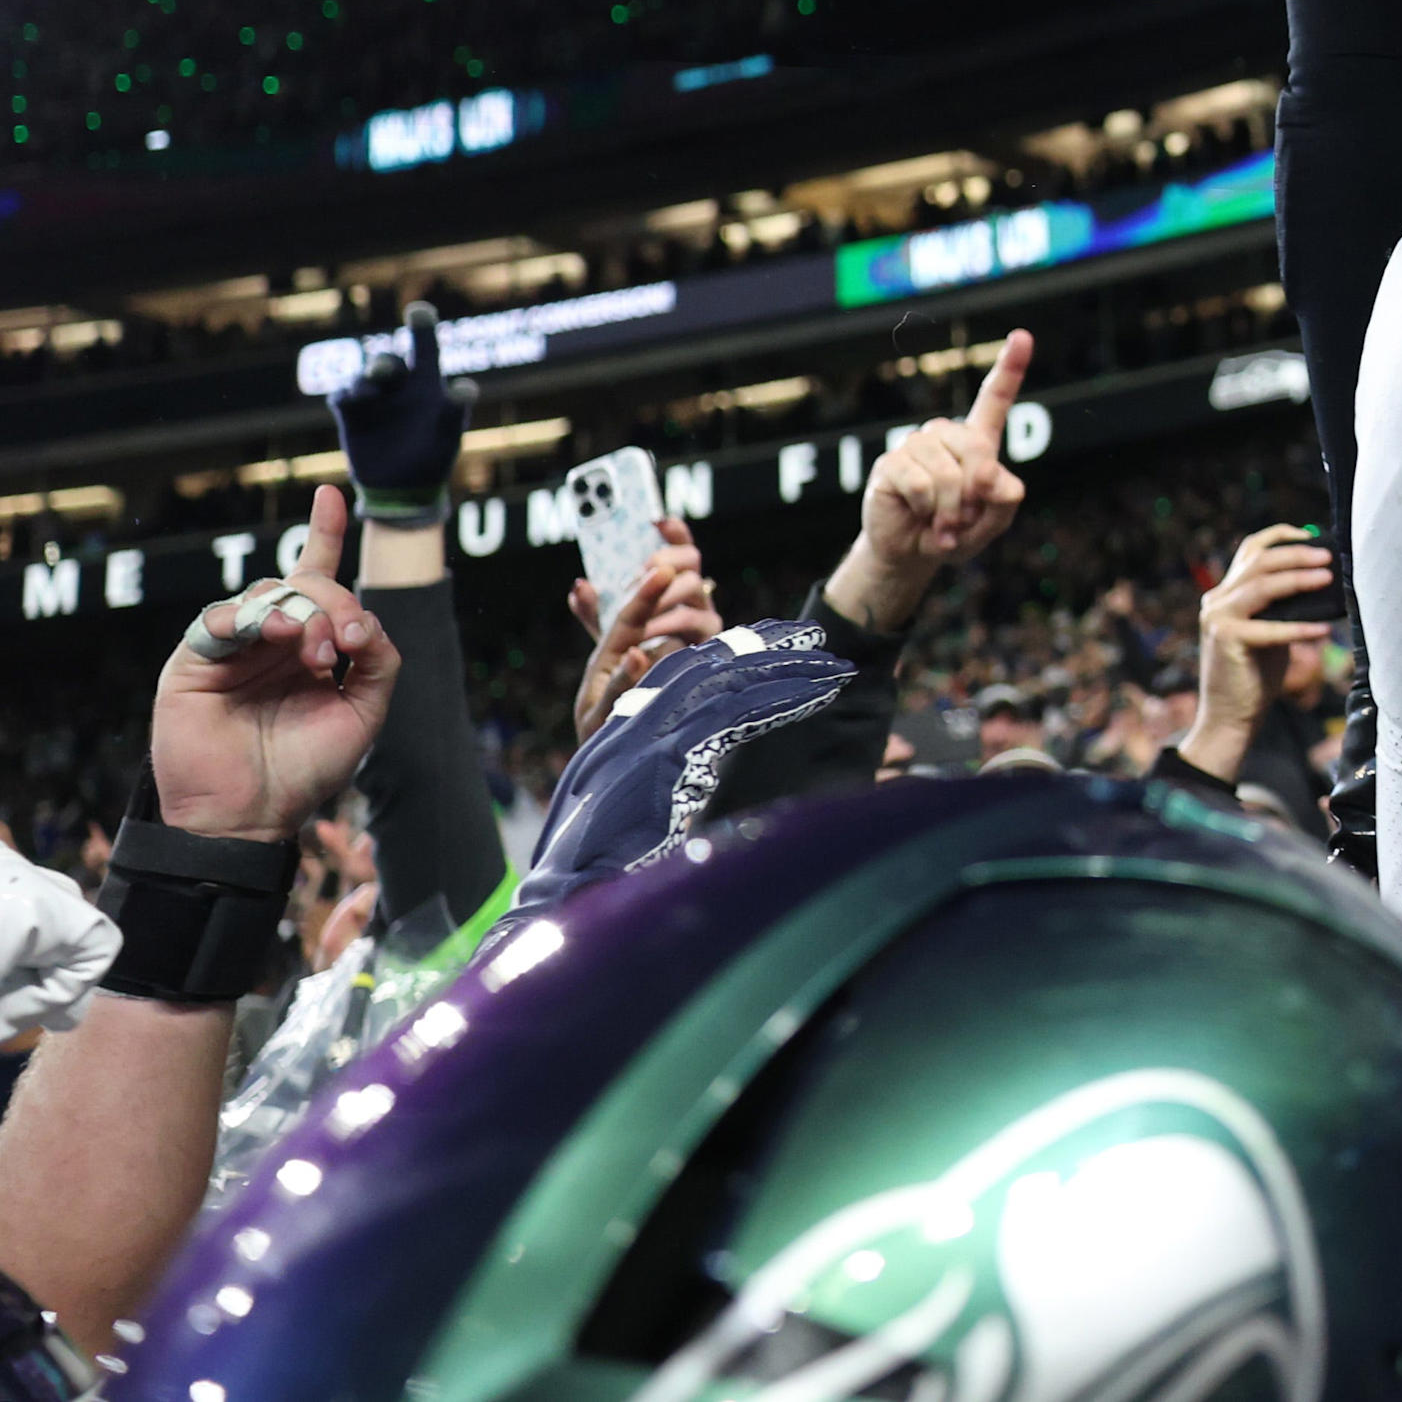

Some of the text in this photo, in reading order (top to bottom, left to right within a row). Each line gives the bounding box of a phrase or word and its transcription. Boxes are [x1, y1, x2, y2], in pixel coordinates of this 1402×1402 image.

[23, 548, 145, 620] ME
[456, 460, 714, 558] UMN
[778, 400, 1053, 504] FID
